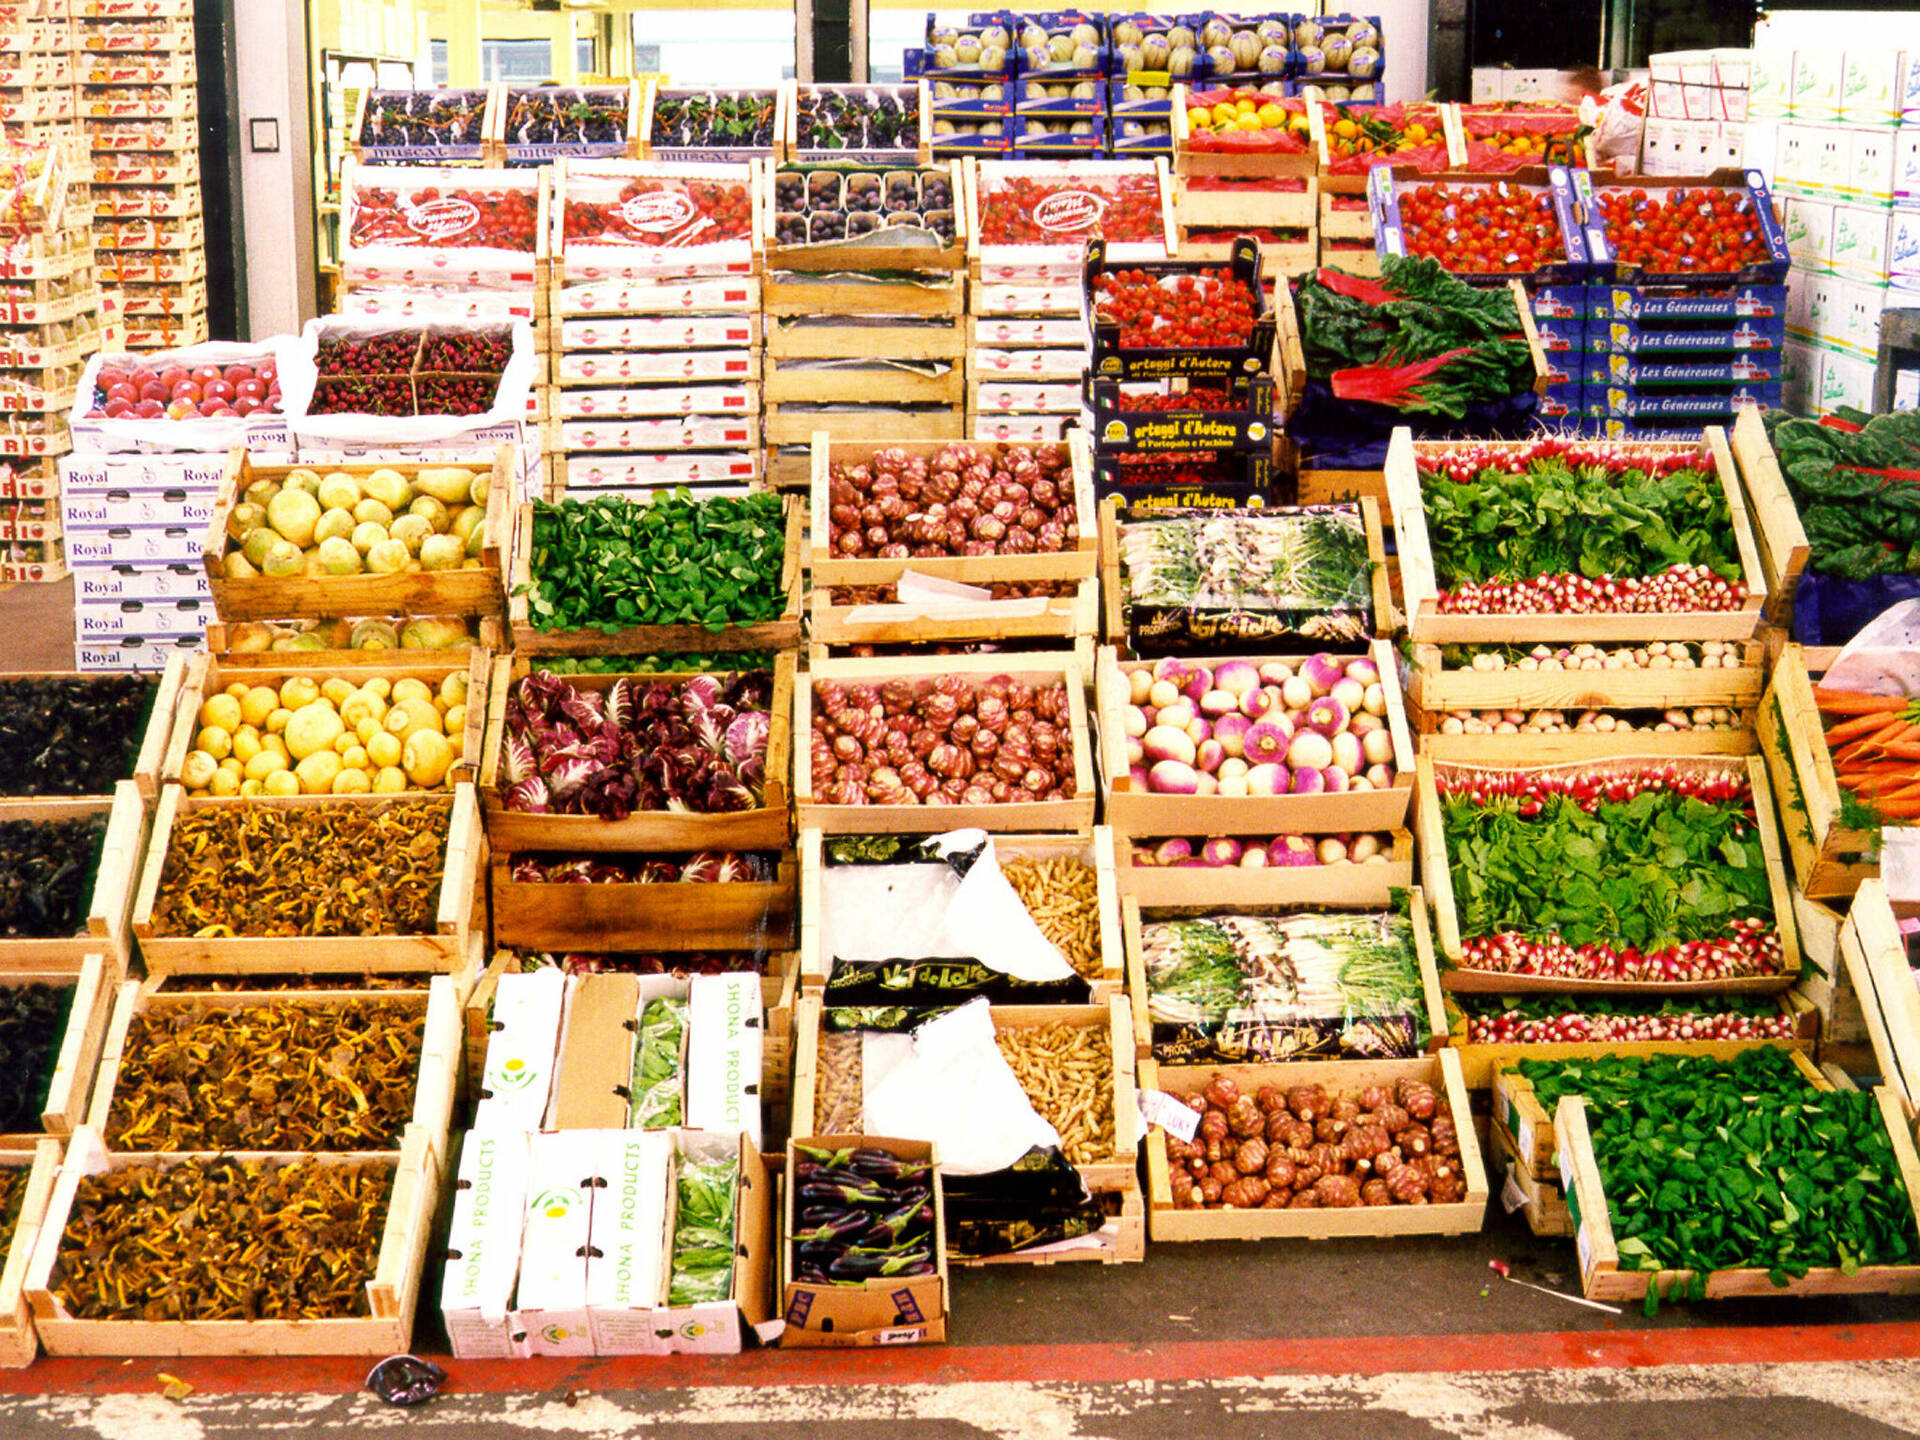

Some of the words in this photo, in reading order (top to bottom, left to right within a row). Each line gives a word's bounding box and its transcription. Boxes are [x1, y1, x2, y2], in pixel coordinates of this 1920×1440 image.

[1644, 301, 1662, 313] Les
[1666, 301, 1729, 313] Généreuses
[1642, 335, 1660, 346] Les
[1664, 334, 1726, 346] Généreuses
[1641, 366, 1659, 378] Les
[1663, 366, 1726, 377] Généreuses
[1640, 399, 1658, 411] Les
[1662, 399, 1724, 411] Généreuses
[69, 471, 108, 485] Royal
[68, 508, 107, 522] Royal
[183, 506, 214, 520] Roy
[73, 543, 112, 558] Royal
[84, 581, 123, 595] Royal
[84, 617, 123, 632] Royal
[82, 651, 121, 665] Royal
[882, 965, 916, 990] Vl
[919, 967, 938, 986] de
[939, 965, 989, 989] Loire
[726, 983, 740, 1038] SHONA
[726, 1051, 740, 1124] PRODUCT
[472, 1139, 495, 1226] PRODUCTS
[620, 1143, 640, 1230] PRODUCTS
[463, 1240, 483, 1296] SHONA
[616, 1243, 632, 1303] SHONA
